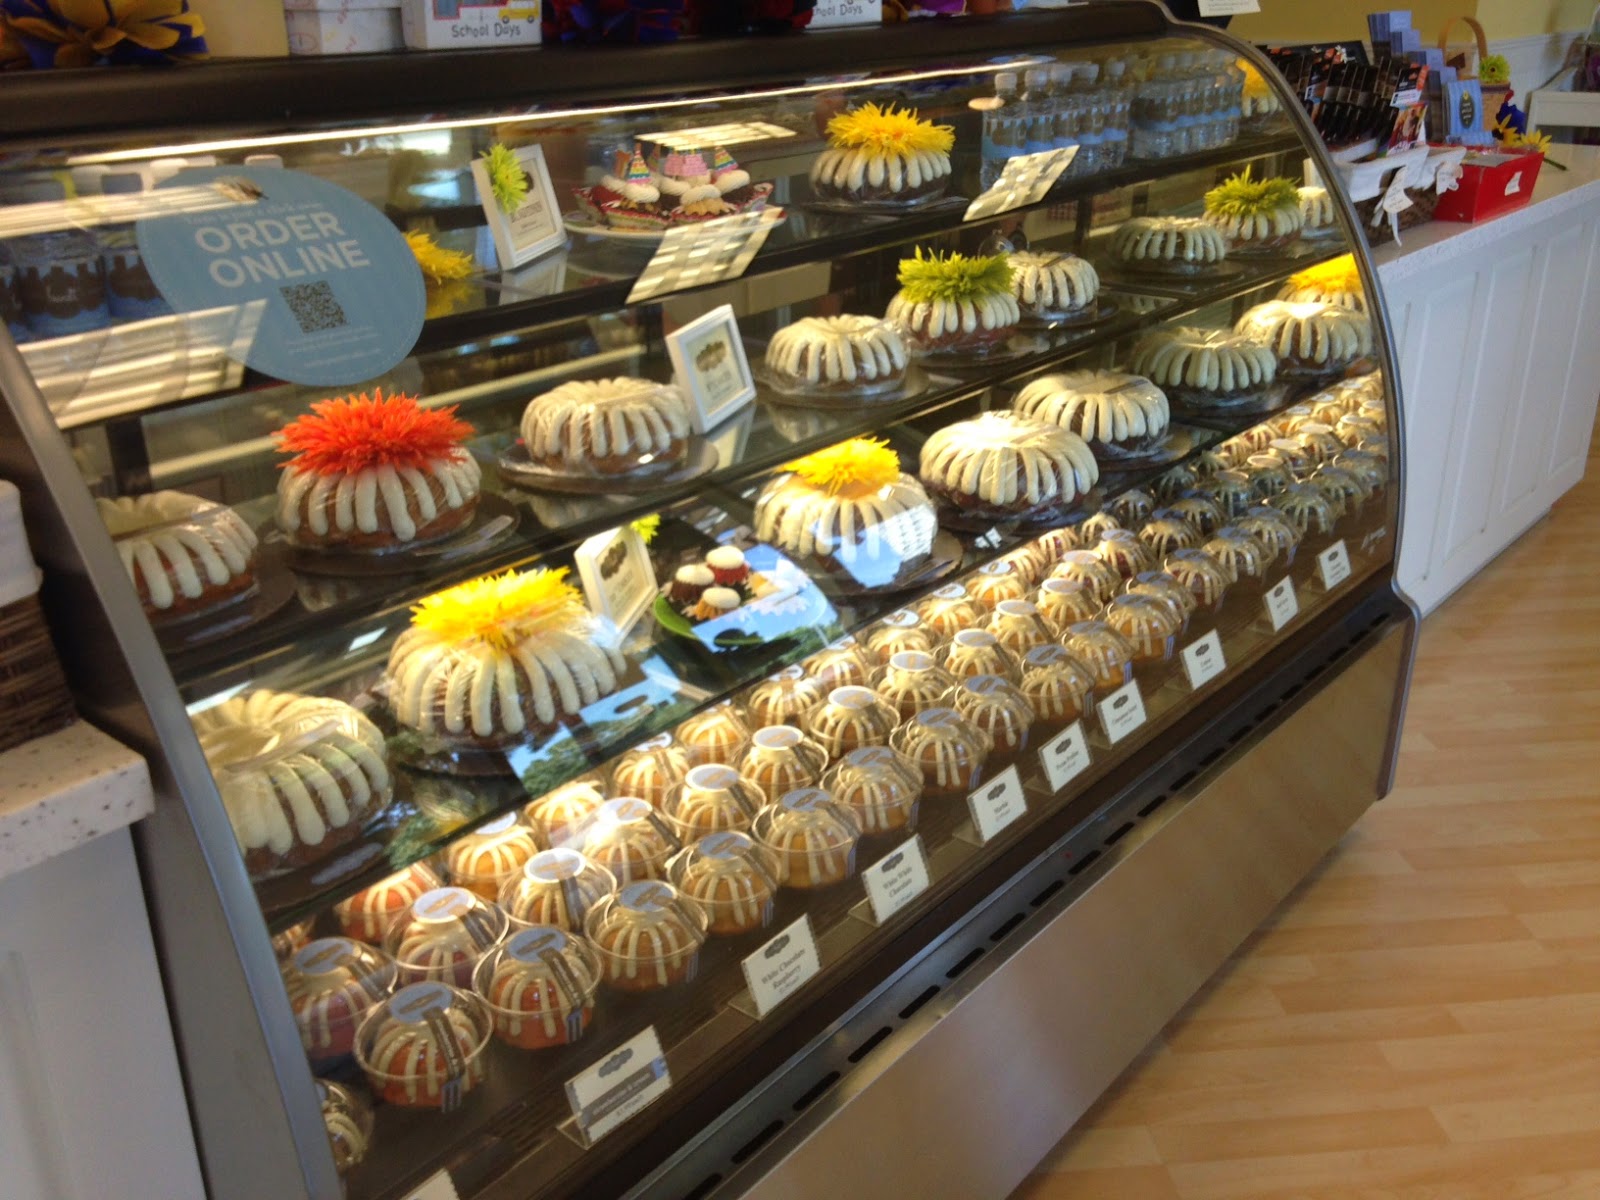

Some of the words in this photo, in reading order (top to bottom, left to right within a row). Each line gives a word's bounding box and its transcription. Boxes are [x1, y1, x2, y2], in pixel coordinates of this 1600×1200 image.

[815, 6, 836, 17] hool
[840, 4, 863, 16] Days
[451, 24, 489, 38] School
[494, 22, 521, 38] Days
[195, 211, 346, 254] ORDER
[208, 239, 371, 288] ONLINE
